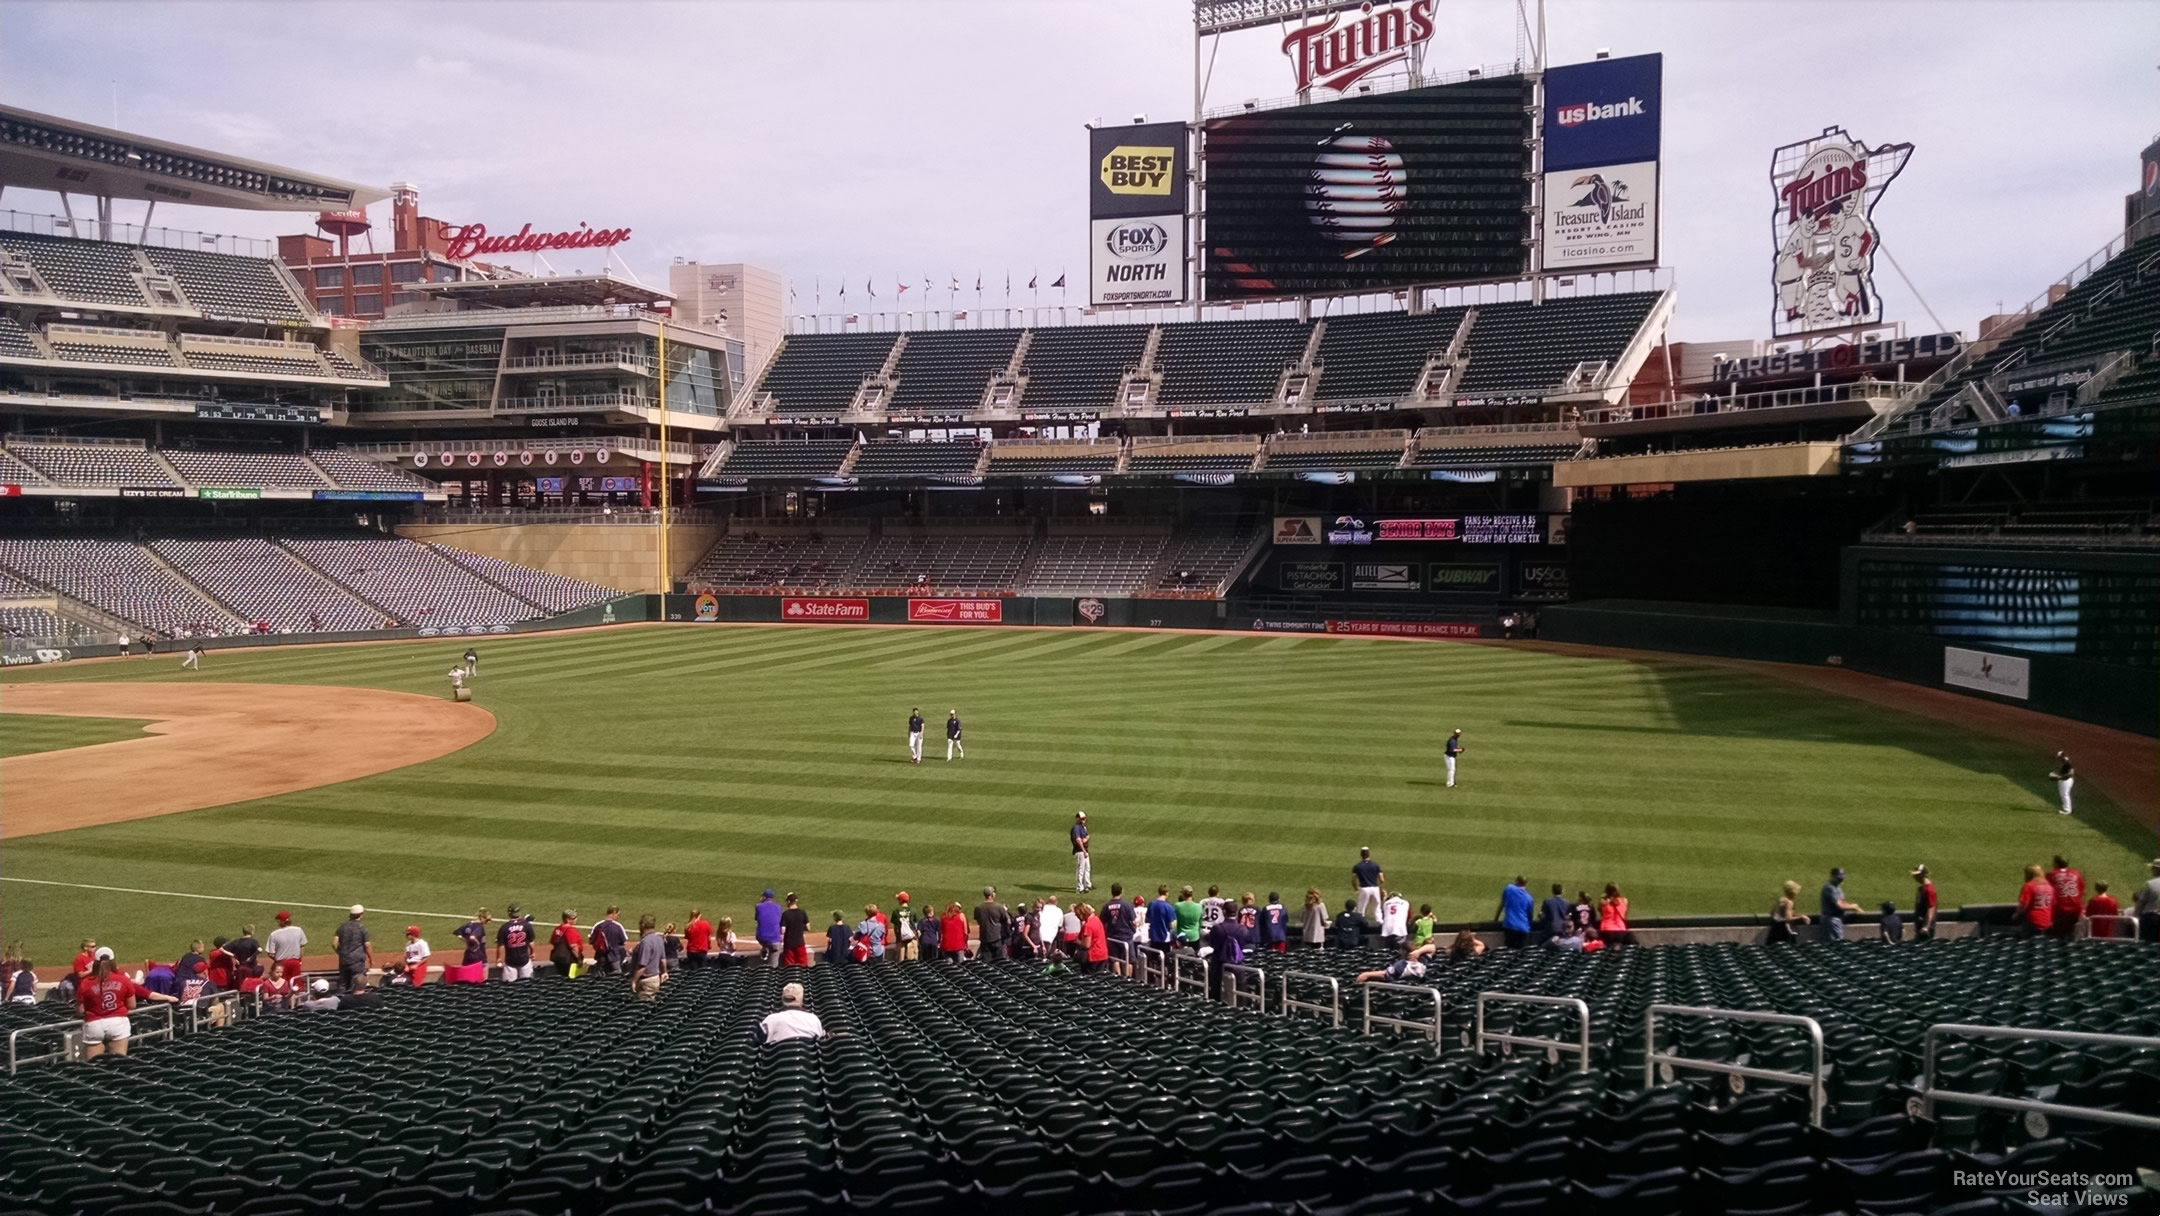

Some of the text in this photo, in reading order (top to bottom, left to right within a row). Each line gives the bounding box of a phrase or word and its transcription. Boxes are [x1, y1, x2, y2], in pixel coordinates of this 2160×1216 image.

[1281, 0, 1435, 95] Twins
[1110, 155, 1172, 171] BEST
[1111, 171, 1166, 187] BUY
[1781, 159, 1867, 225] Twins
[1554, 202, 1645, 226] Treasure Island
[439, 221, 632, 260] Budweiser
[1119, 228, 1154, 245] FOX
[1119, 245, 1156, 253] SPORTS
[1563, 245, 1634, 257] ticasino.com
[1107, 263, 1166, 282] NORTH
[1103, 290, 1172, 301] FOXSPORTSNORTH.COM
[399, 346, 437, 358] BEAUTIFUL
[440, 346, 452, 356] DAY
[466, 344, 500, 355] BASEBALL
[1712, 332, 1962, 383] TARGET FIELD
[532, 417, 579, 427] GOOSE ISLAND PUB
[212, 491, 258, 499] StarTribune
[1465, 516, 1480, 525] FANS
[1494, 516, 1520, 525] RECEIVE
[1522, 516, 1527, 525] A
[1528, 515, 1536, 525] $5
[1379, 522, 1422, 538] SENIOR
[1424, 522, 1456, 538] DAYS
[1466, 525, 1535, 534] DISCOUNT ON SELECT
[1462, 534, 1540, 543] WEEKDAY DAY GAME TIX
[1287, 572, 1338, 580] PISTACHIOS
[1433, 569, 1497, 583] SUBWAY
[1336, 621, 1351, 632] 25
[1351, 623, 1371, 631] YEARS
[1371, 624, 1380, 632] OF
[1381, 624, 1400, 632] GIVING
[1402, 624, 1417, 632] KIDS
[1424, 625, 1449, 634] CHANCE
[1450, 626, 1459, 634] TO
[3, 654, 33, 665] Twins
[1203, 906, 1219, 921] 16
[1270, 909, 1280, 924] 7
[1390, 904, 1397, 915] 5
[507, 931, 526, 947] 22
[102, 991, 117, 1010] 2
